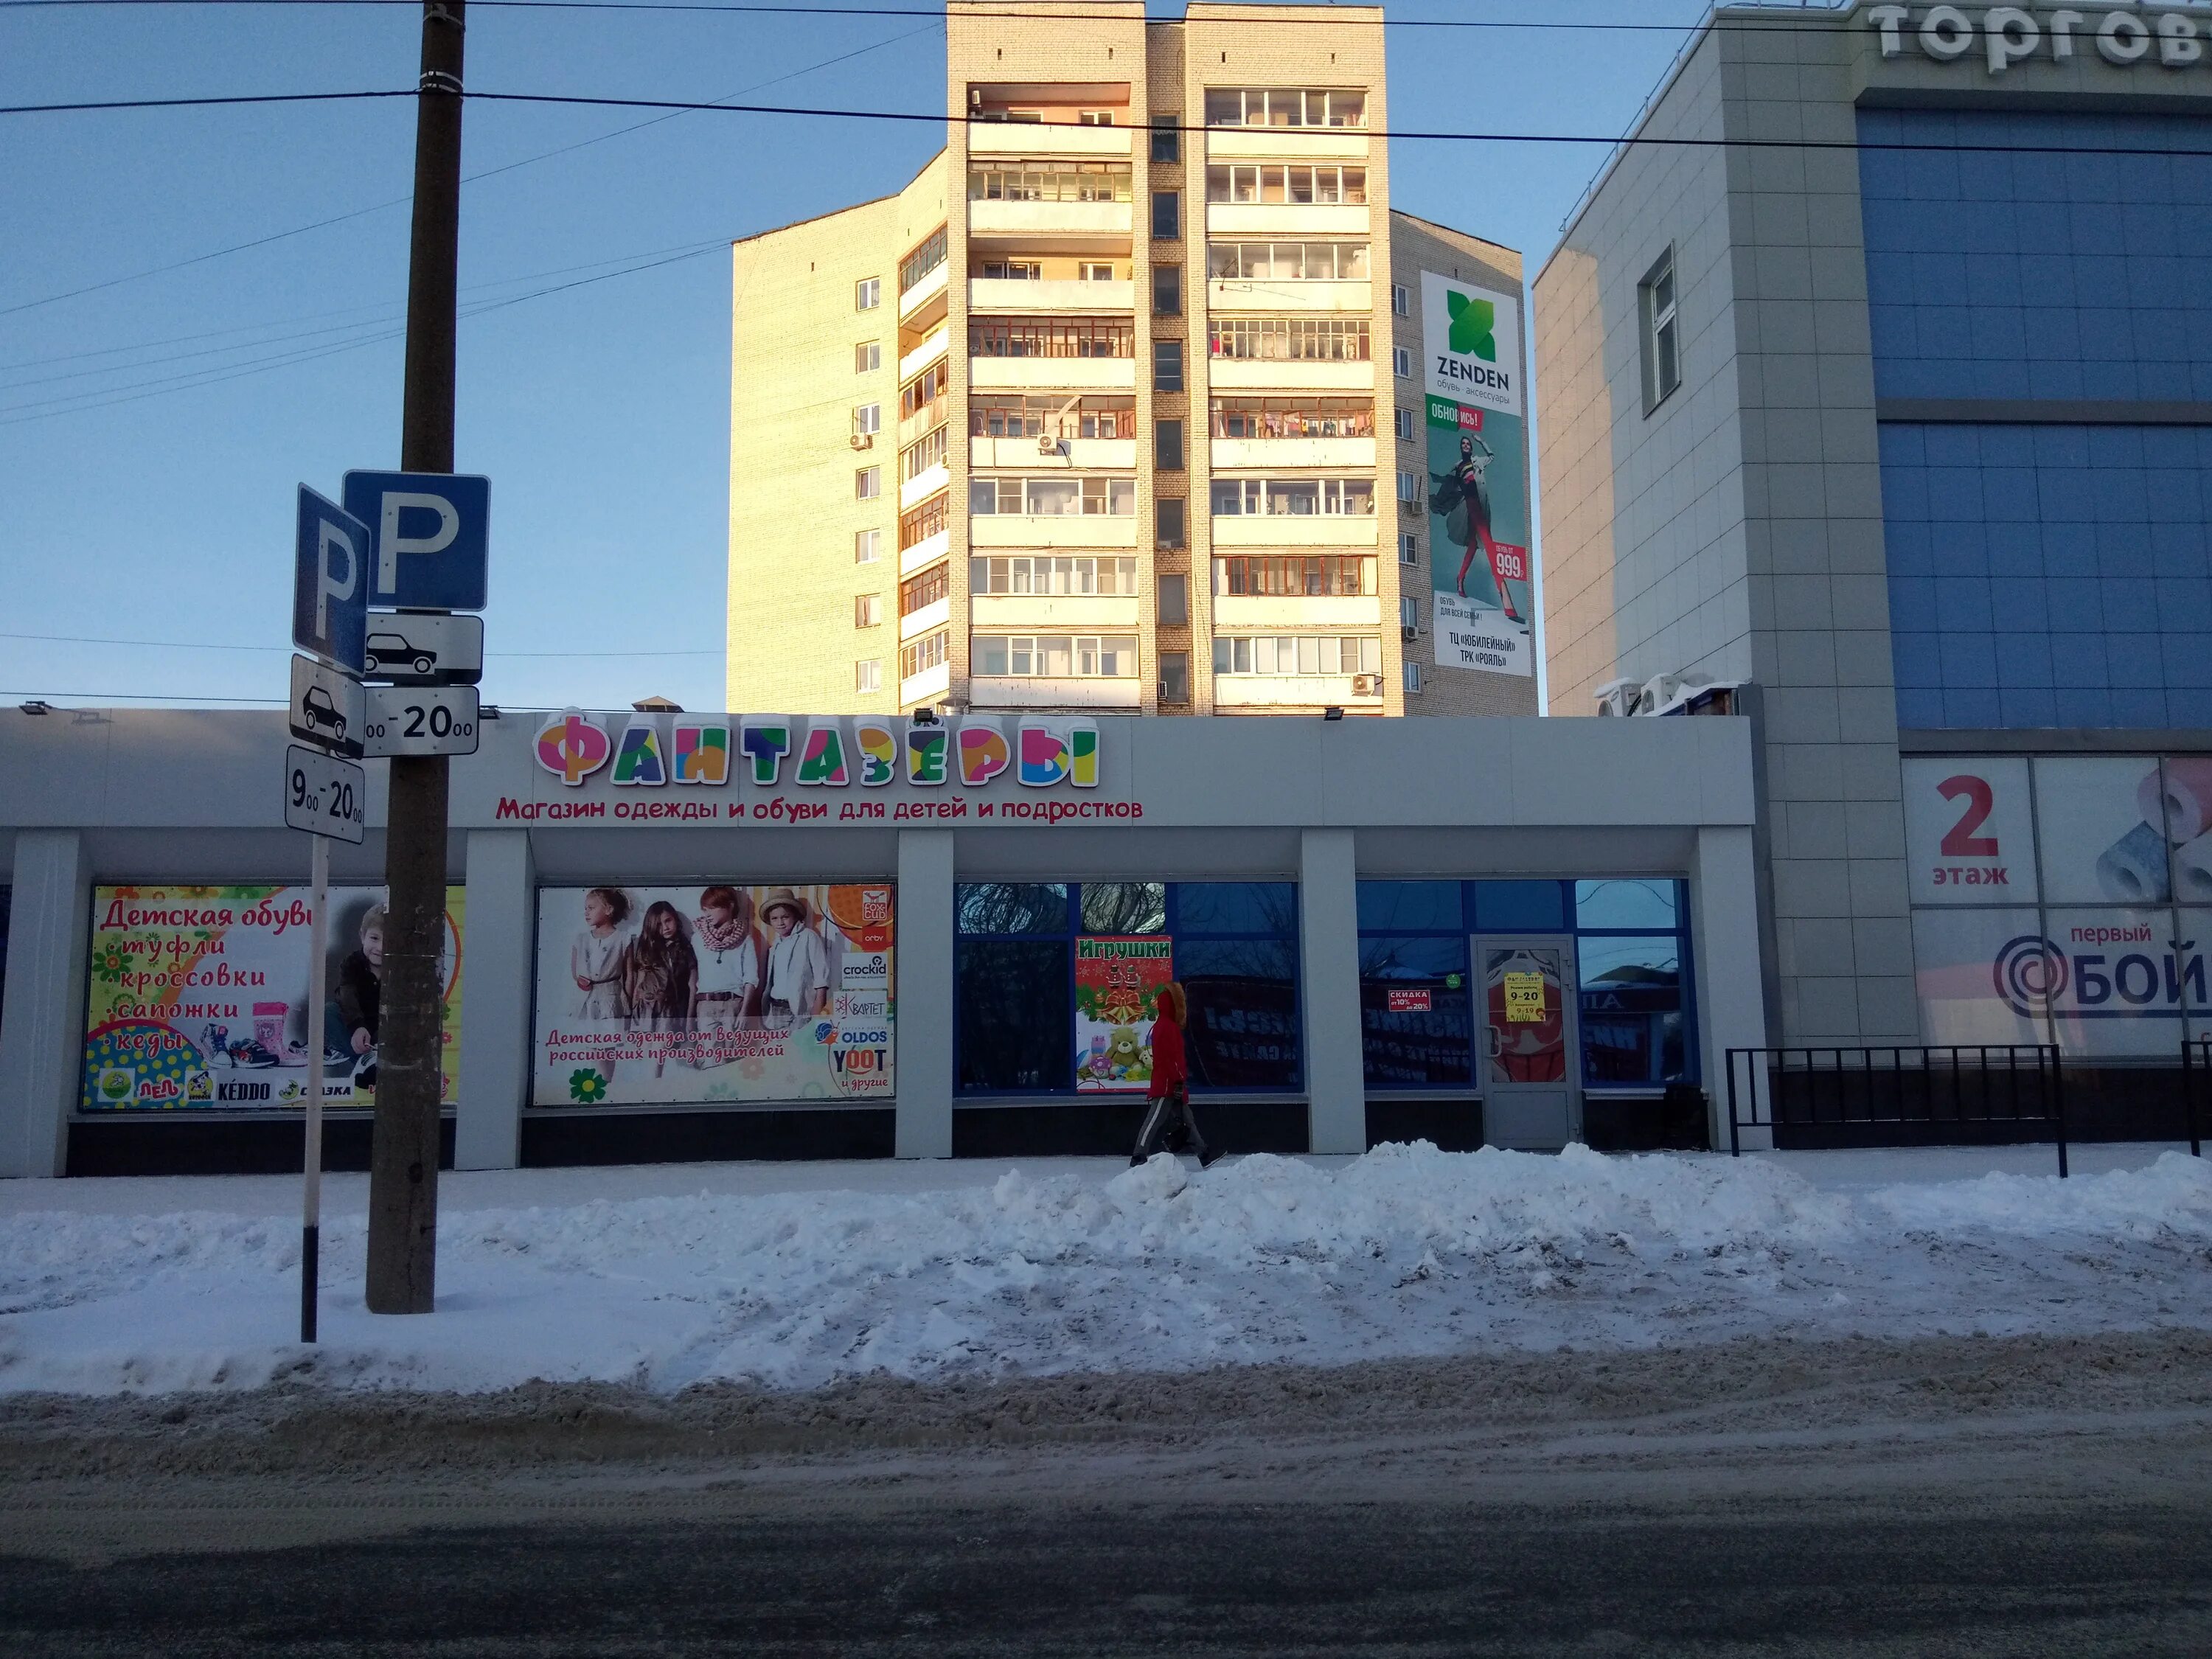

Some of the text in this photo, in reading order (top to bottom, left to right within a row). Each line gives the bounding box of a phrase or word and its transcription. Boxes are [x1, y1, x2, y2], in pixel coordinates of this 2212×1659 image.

[1437, 355, 1509, 392] ZENDEN
[1437, 378, 1510, 404] обувь аксессуары
[378, 491, 460, 594] P
[1496, 552, 1521, 578] 999
[315, 518, 358, 640] P
[1439, 596, 1455, 606] ОБУВЬ
[1440, 607, 1451, 616] ДЛЯ
[1451, 608, 1464, 618] ВСЕЙ
[1449, 632, 1516, 652] ТЦ «ЮБИЛЕЙНЫЙ»
[1460, 650, 1506, 667] ТРК «РОЯЛЬ»
[495, 796, 1143, 824] Магазин одежды и обуви для детей и подростков
[1936, 775, 1999, 857] 2
[1933, 866, 2010, 886] этаж
[100, 899, 234, 931] Детская
[2070, 923, 2152, 946] первый
[122, 934, 226, 962] туфли
[1079, 938, 1172, 960] Игрушки
[120, 962, 266, 995] кроссовки
[843, 963, 886, 975] crockid
[1511, 992, 1538, 1001] 9-20
[117, 1003, 239, 1018] сапожки
[116, 1033, 183, 1058] кеды
[546, 1026, 790, 1048] Детская одежда от ведущих
[842, 1031, 887, 1043] OLDOS
[549, 1044, 785, 1066] российских производителей
[218, 1079, 271, 1101] KÉDDO
[300, 1086, 351, 1096] СЗКА
[852, 1079, 888, 1091] другие
